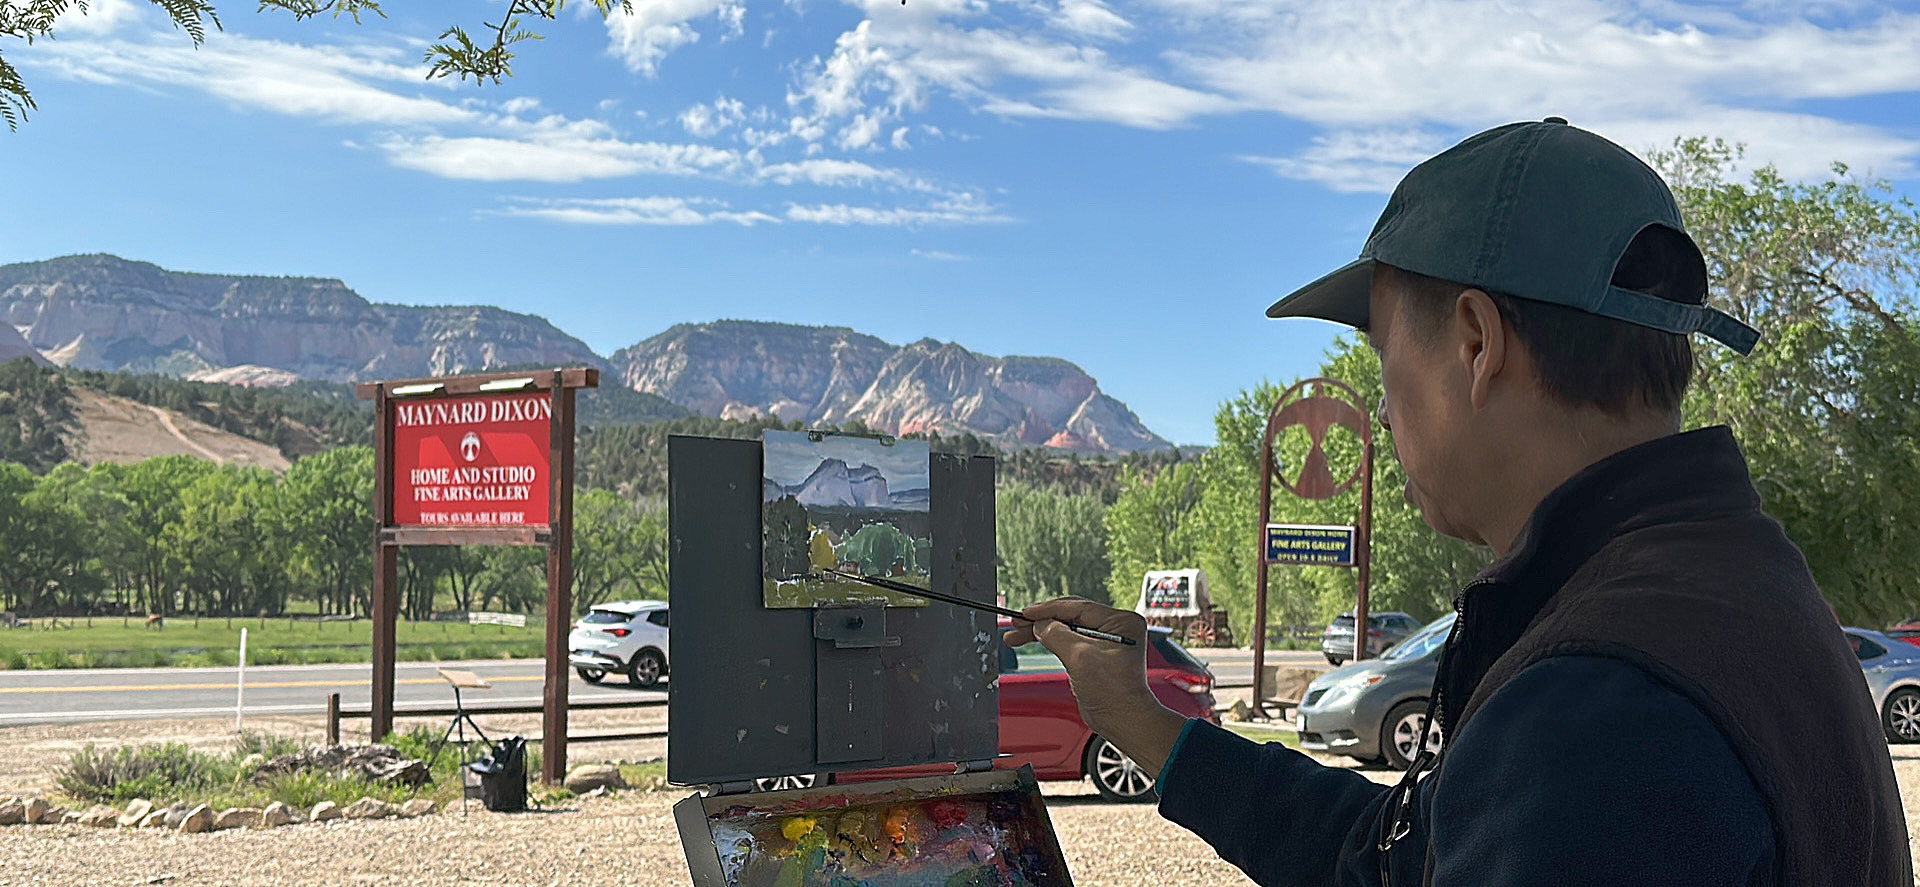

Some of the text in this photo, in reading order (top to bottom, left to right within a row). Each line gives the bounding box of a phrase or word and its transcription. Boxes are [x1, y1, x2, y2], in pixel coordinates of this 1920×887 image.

[398, 398, 552, 426] MAYNARD DIXON
[411, 466, 535, 485] HOME AND STUDIO
[414, 485, 531, 501] FINE ARTS GALLERY
[420, 512, 525, 525] TOURS AVAILABLE HERE
[1272, 539, 1346, 551] FINE ARTS GALLERY
